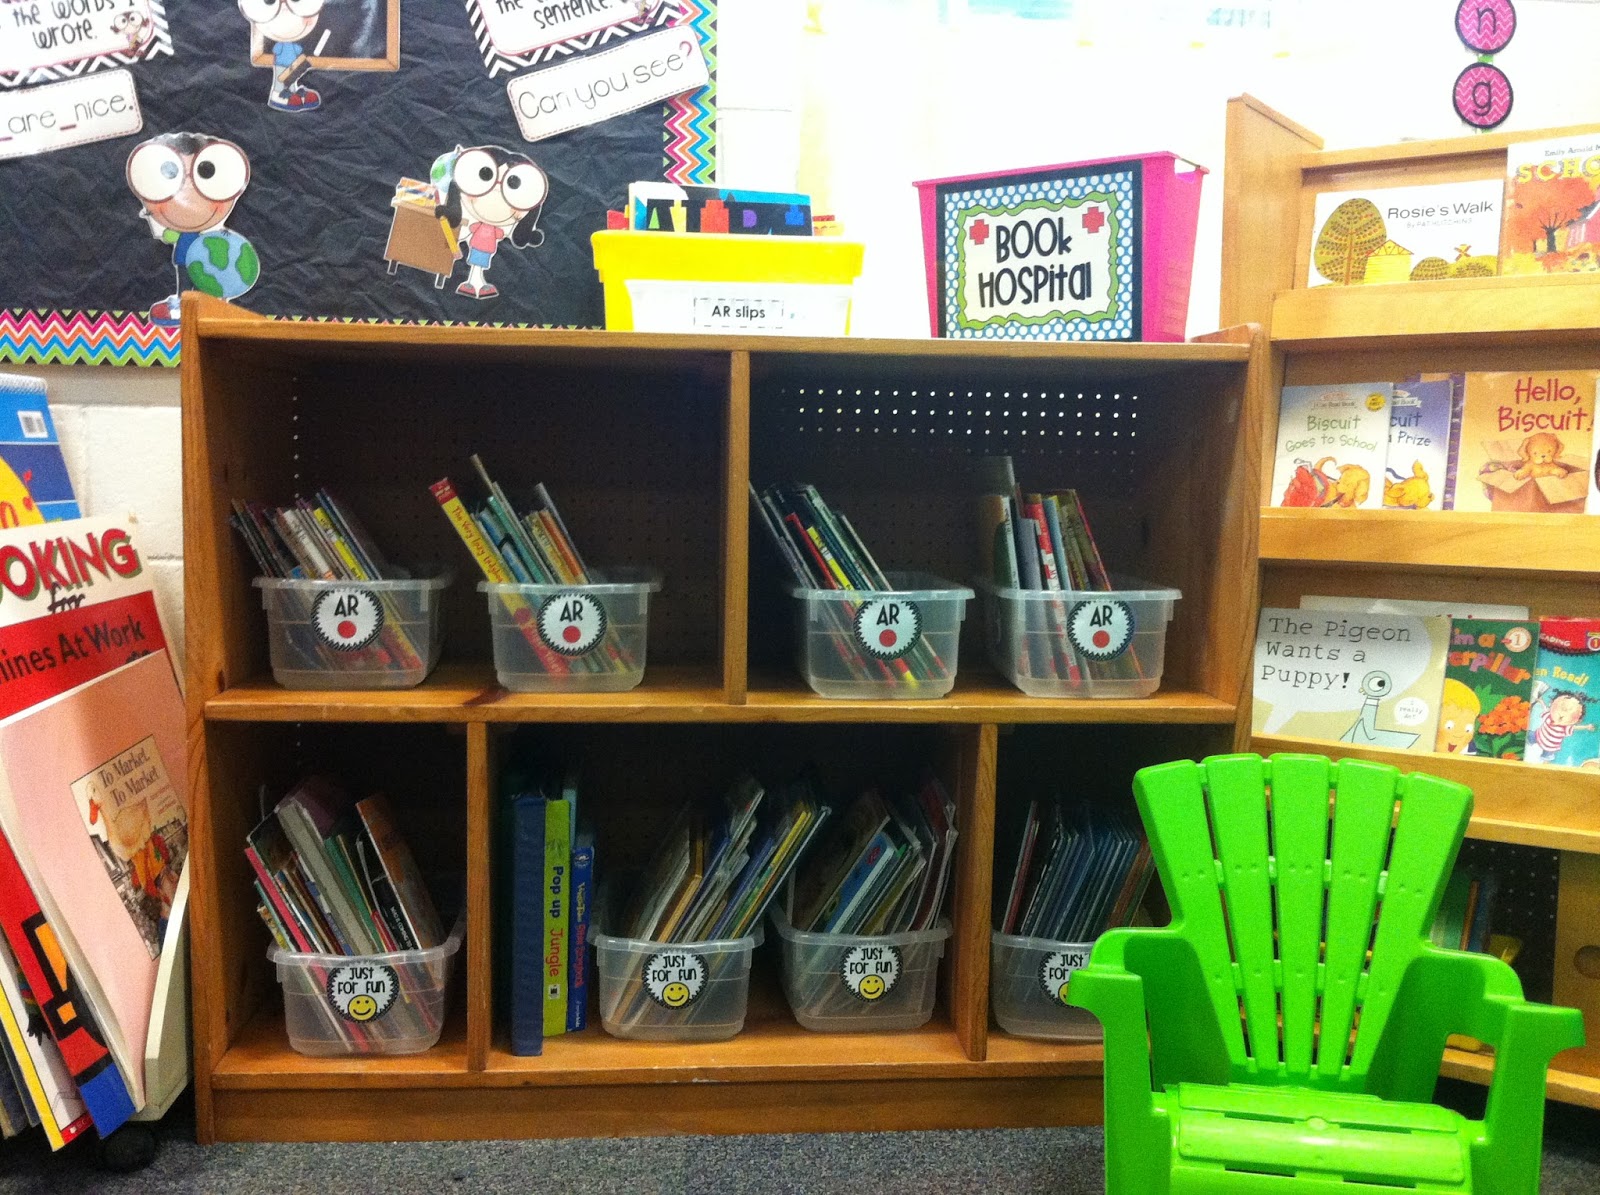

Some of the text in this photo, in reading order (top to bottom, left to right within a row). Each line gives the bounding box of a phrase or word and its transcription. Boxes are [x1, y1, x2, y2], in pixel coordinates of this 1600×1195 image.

[13, 4, 41, 27] the
[1478, 7, 1496, 34] n
[32, 19, 97, 49] wrote.
[518, 40, 693, 119] Can you see?
[1472, 81, 1492, 116] g
[1388, 201, 1494, 219] Rosie's Walk
[711, 305, 766, 319] AR slips
[1514, 377, 1582, 404] Hello,
[1306, 415, 1361, 431] Biscuit
[1390, 412, 1423, 427] cuit
[1285, 437, 1315, 452] Goes
[1321, 434, 1334, 444] to
[1340, 434, 1378, 452] School
[1398, 431, 1432, 446] Prize
[0, 528, 142, 601] OKING
[334, 594, 359, 617] AR
[559, 599, 583, 622] AR
[876, 603, 900, 626] AR
[1089, 605, 1113, 627] AR
[58, 632, 89, 665] At
[83, 615, 145, 652] Work
[1269, 618, 1411, 643] The Pigeon
[1478, 634, 1496, 648] a
[1514, 634, 1521, 645] 1
[1540, 633, 1571, 647] EADING
[1266, 641, 1366, 662] Wants a
[1261, 665, 1350, 690] Puppy!
[1448, 651, 1531, 685] erpillar
[97, 769, 114, 789] To
[110, 788, 127, 807] To
[125, 766, 159, 795] Market
[545, 866, 564, 977] Pop up Jungle
